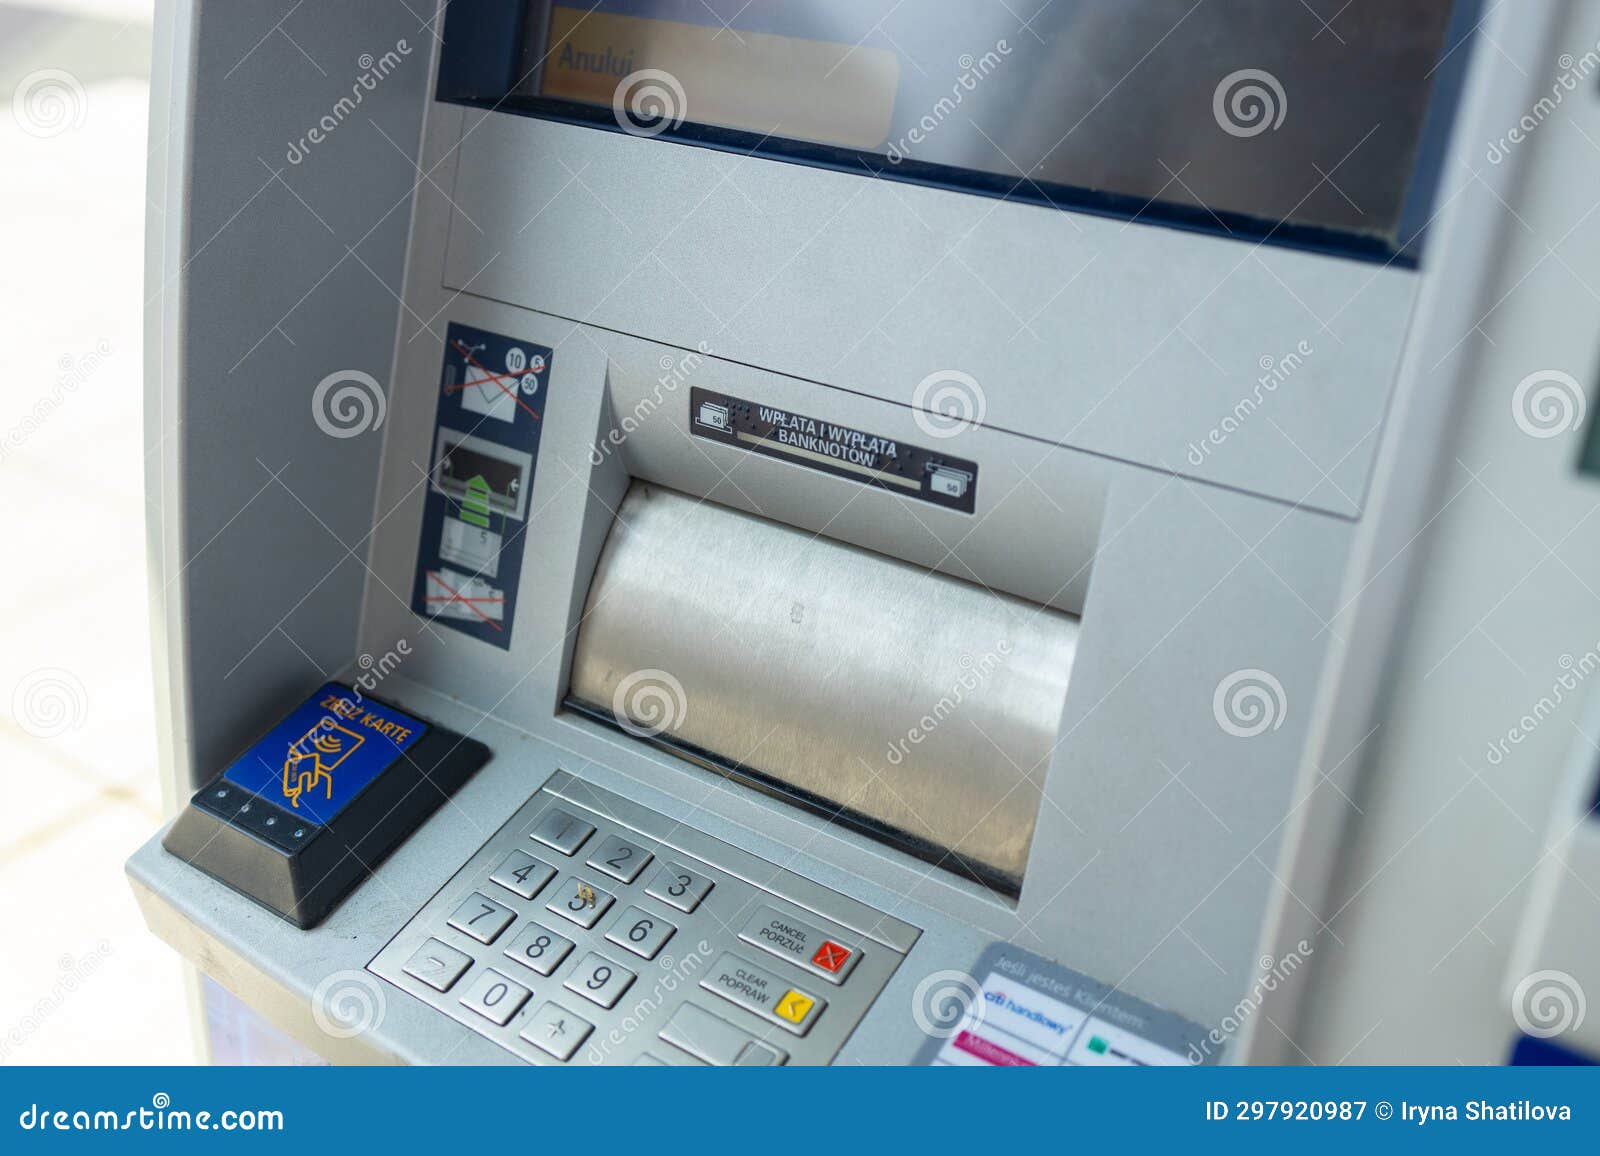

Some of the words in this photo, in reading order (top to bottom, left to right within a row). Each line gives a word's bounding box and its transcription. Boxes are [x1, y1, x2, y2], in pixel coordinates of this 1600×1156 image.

[759, 407, 815, 435] WPŁATA
[820, 422, 825, 437] I
[828, 425, 897, 458] WYPŁATA
[778, 429, 875, 467] BANKNOTÓW
[360, 712, 412, 744] KARTĘ
[606, 847, 633, 869] 2
[511, 863, 536, 884] 4
[668, 875, 692, 897] 3
[468, 903, 496, 925] 7
[628, 919, 653, 942] 6
[770, 920, 808, 942] CANCEL
[526, 935, 551, 959] 8
[586, 966, 612, 990] 9
[719, 974, 770, 1004] POPRAW
[735, 969, 768, 988] CLEAR
[483, 982, 508, 1007] 0
